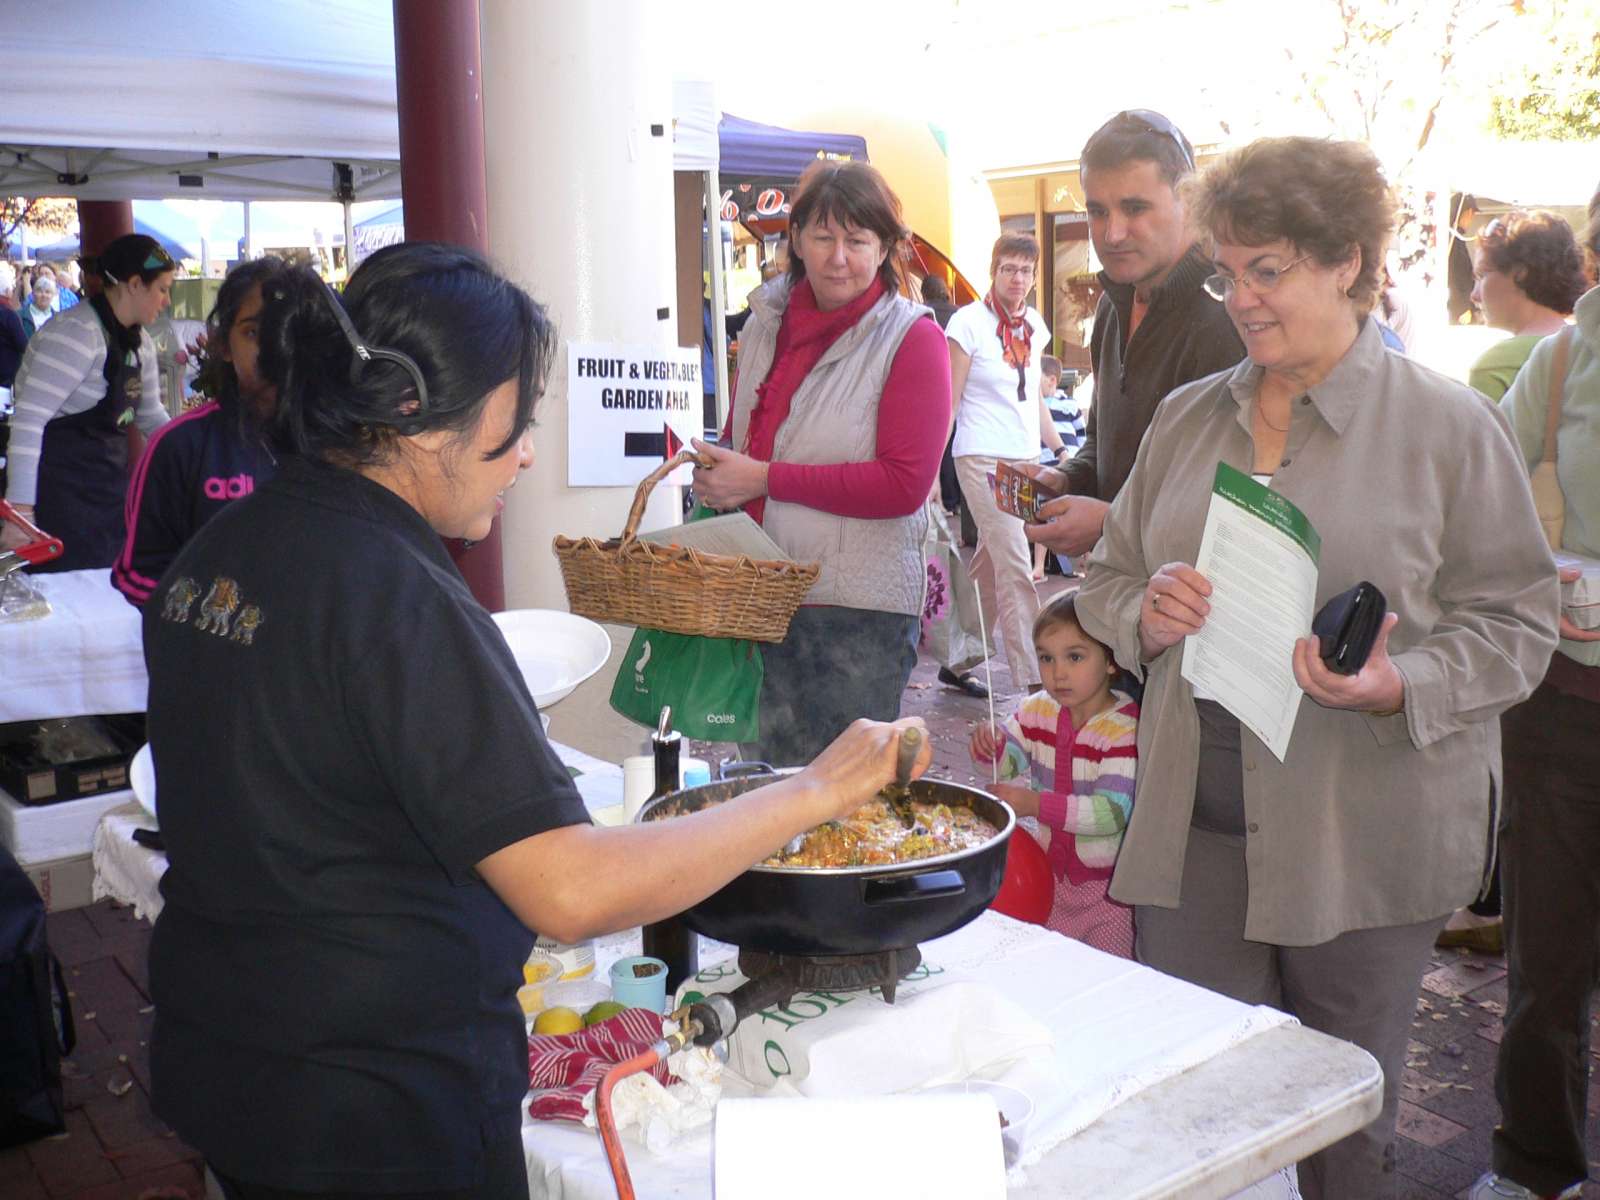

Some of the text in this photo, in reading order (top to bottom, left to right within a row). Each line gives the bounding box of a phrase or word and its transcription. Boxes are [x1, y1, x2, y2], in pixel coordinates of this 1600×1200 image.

[577, 358, 625, 378] FRUIT
[629, 362, 640, 379] &
[601, 388, 690, 411] GARDEN AREA
